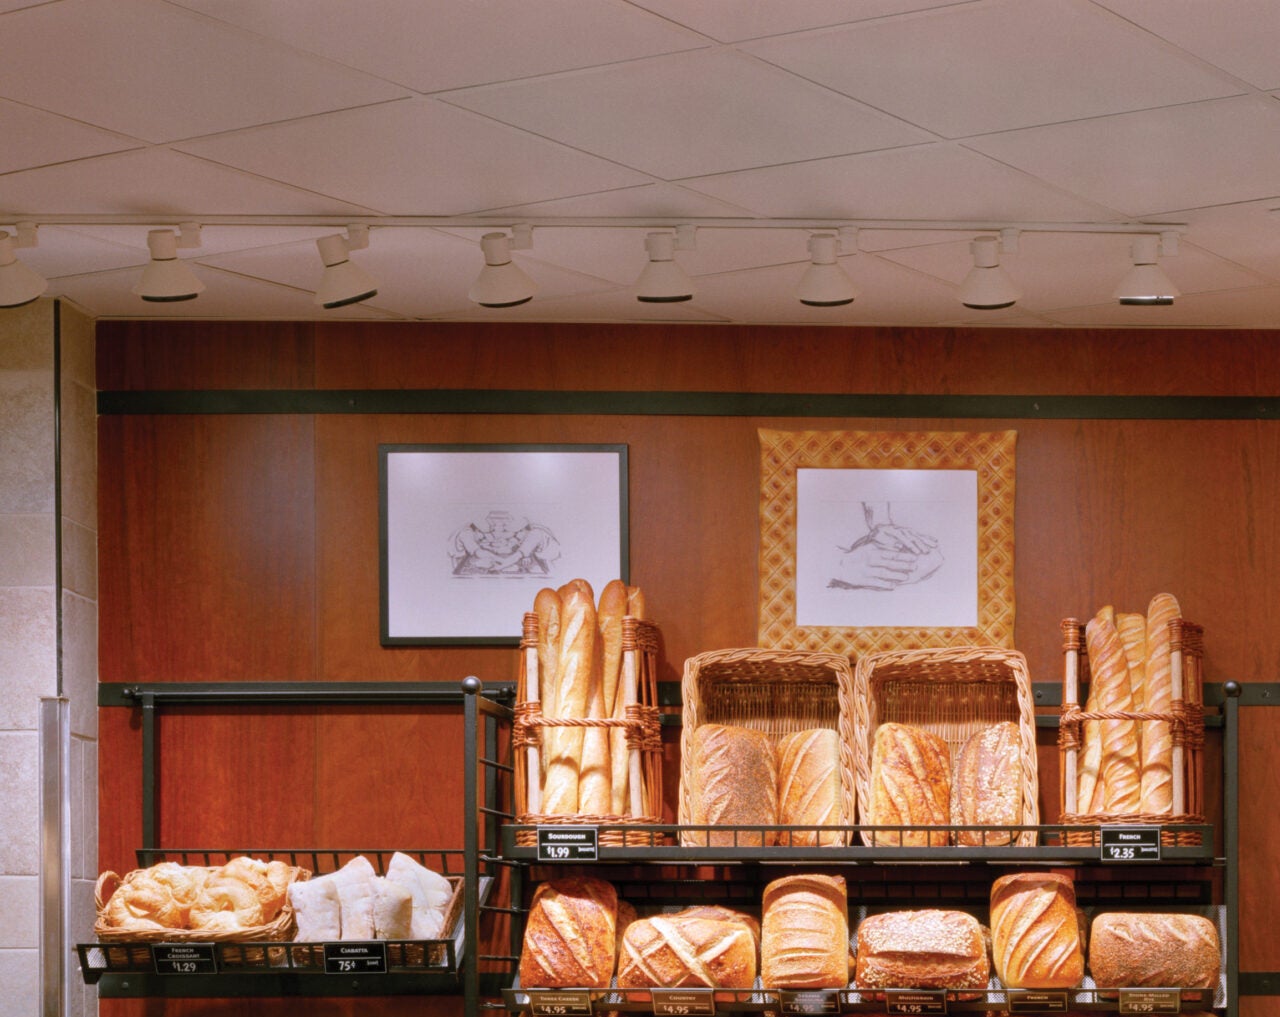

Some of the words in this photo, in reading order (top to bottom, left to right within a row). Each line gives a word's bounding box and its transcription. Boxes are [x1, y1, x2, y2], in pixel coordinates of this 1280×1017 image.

[547, 846, 570, 858] $1.99
[1110, 846, 1135, 858] $2.35
[172, 961, 196, 972] $1.29
[338, 960, 356, 971] 75¢
[541, 1005, 566, 1014] $4.95
[663, 1005, 689, 1014] $4.95
[897, 1004, 921, 1013] $4.95
[1129, 1003, 1153, 1012] $4.95
